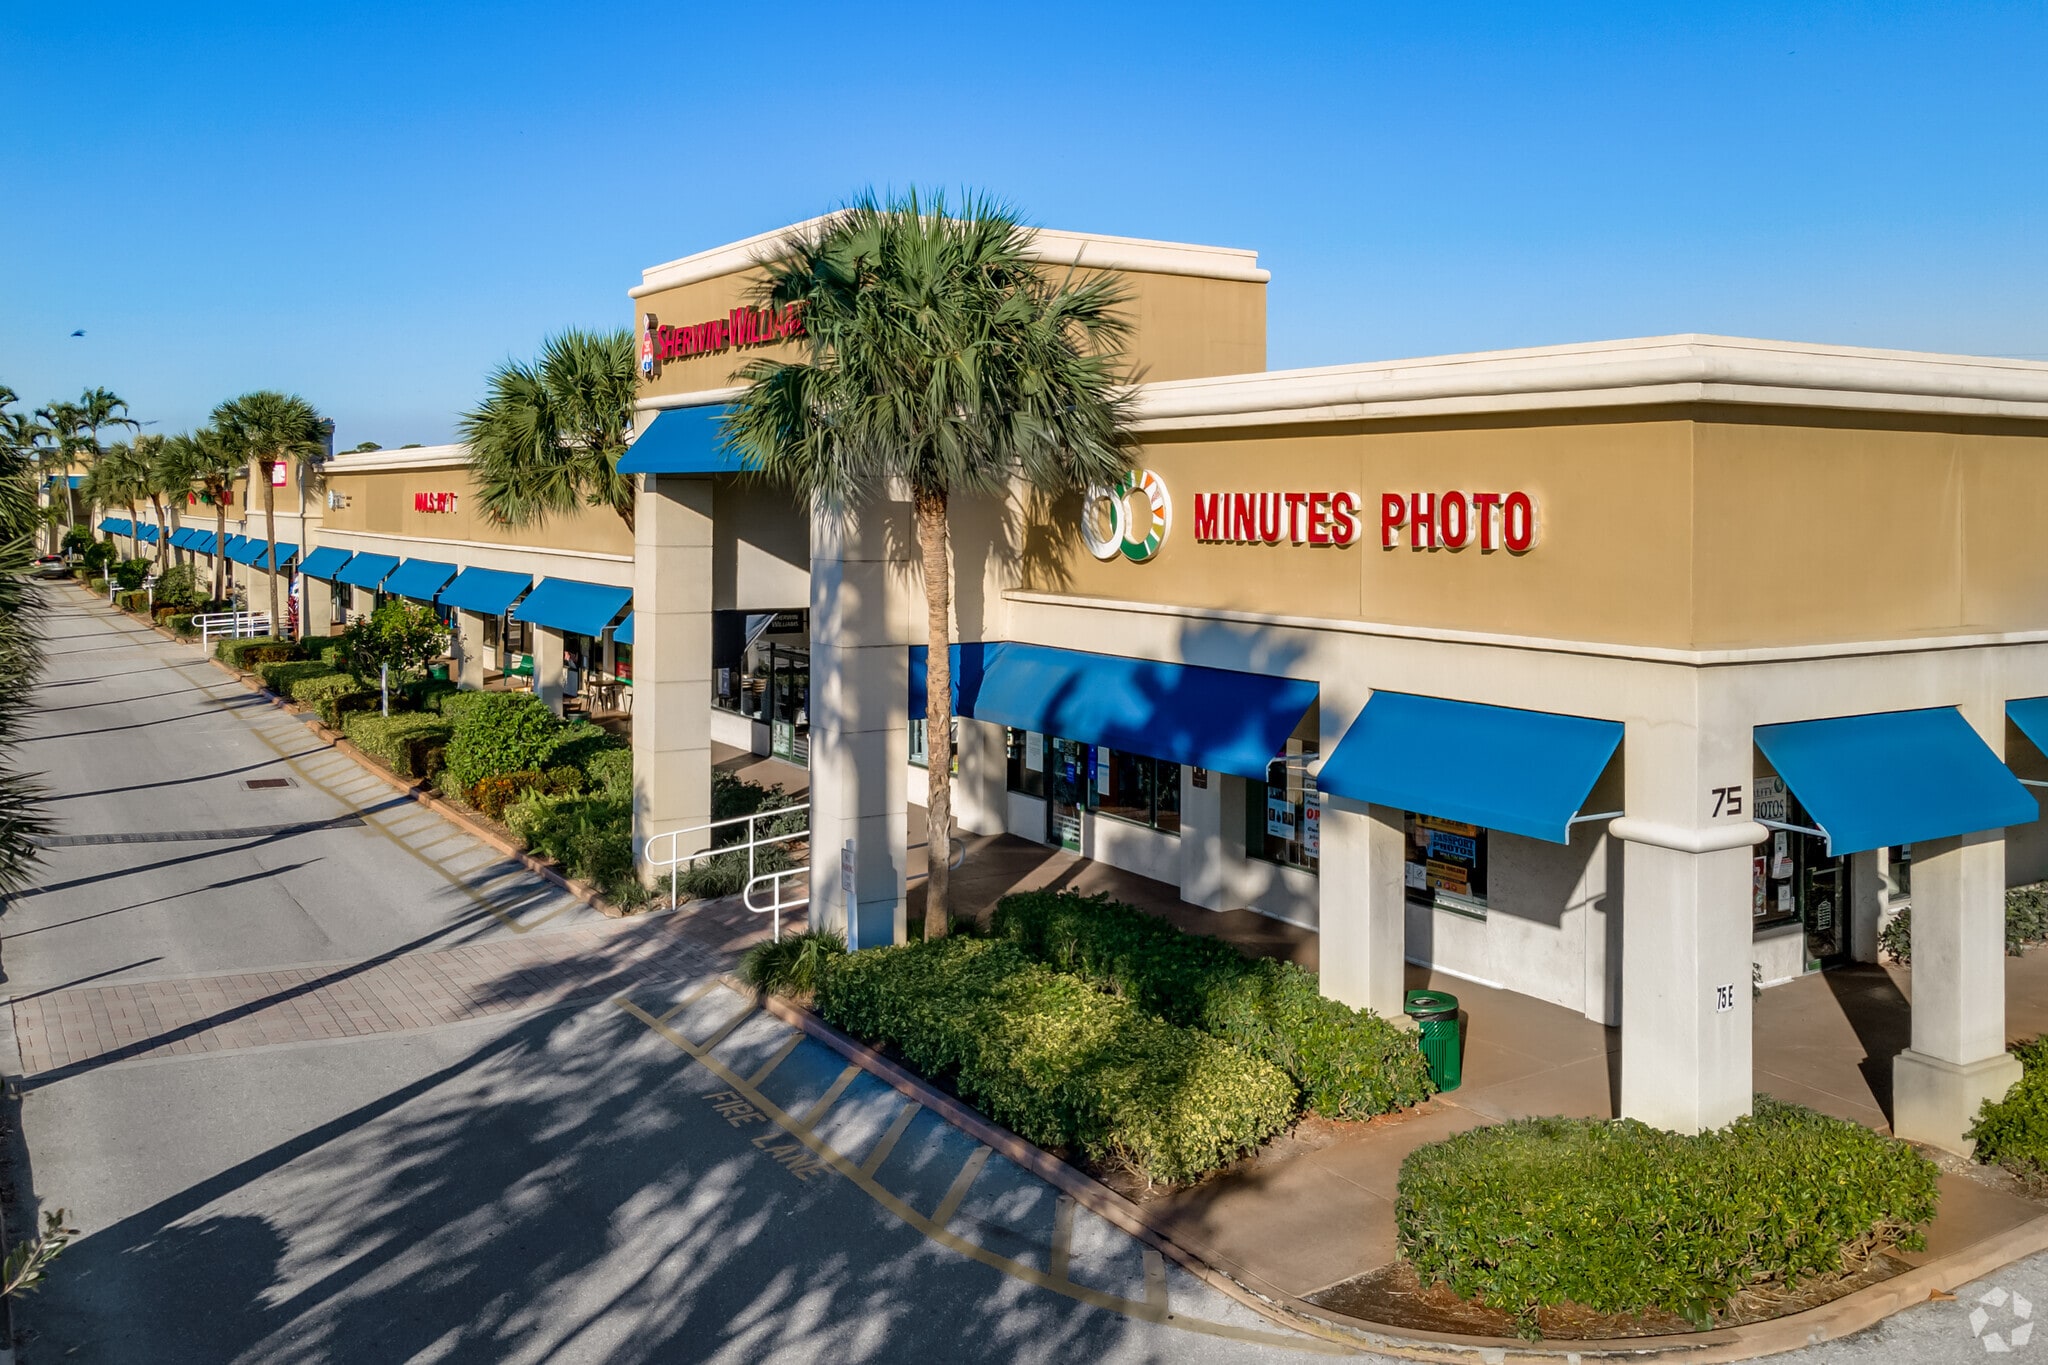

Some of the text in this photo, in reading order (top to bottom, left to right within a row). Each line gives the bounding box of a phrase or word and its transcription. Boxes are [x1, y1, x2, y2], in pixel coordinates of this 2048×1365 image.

[1194, 491, 1361, 544] MINUTES
[1381, 490, 1537, 551] PHOTO
[1711, 785, 1742, 818] 75
[1753, 799, 1784, 819] HOTOS
[1432, 831, 1474, 849] PASSPORT
[1432, 841, 1474, 857] PHOTOS
[1717, 985, 1734, 1010] 75 E
[702, 1090, 838, 1181] FIRE LANE
